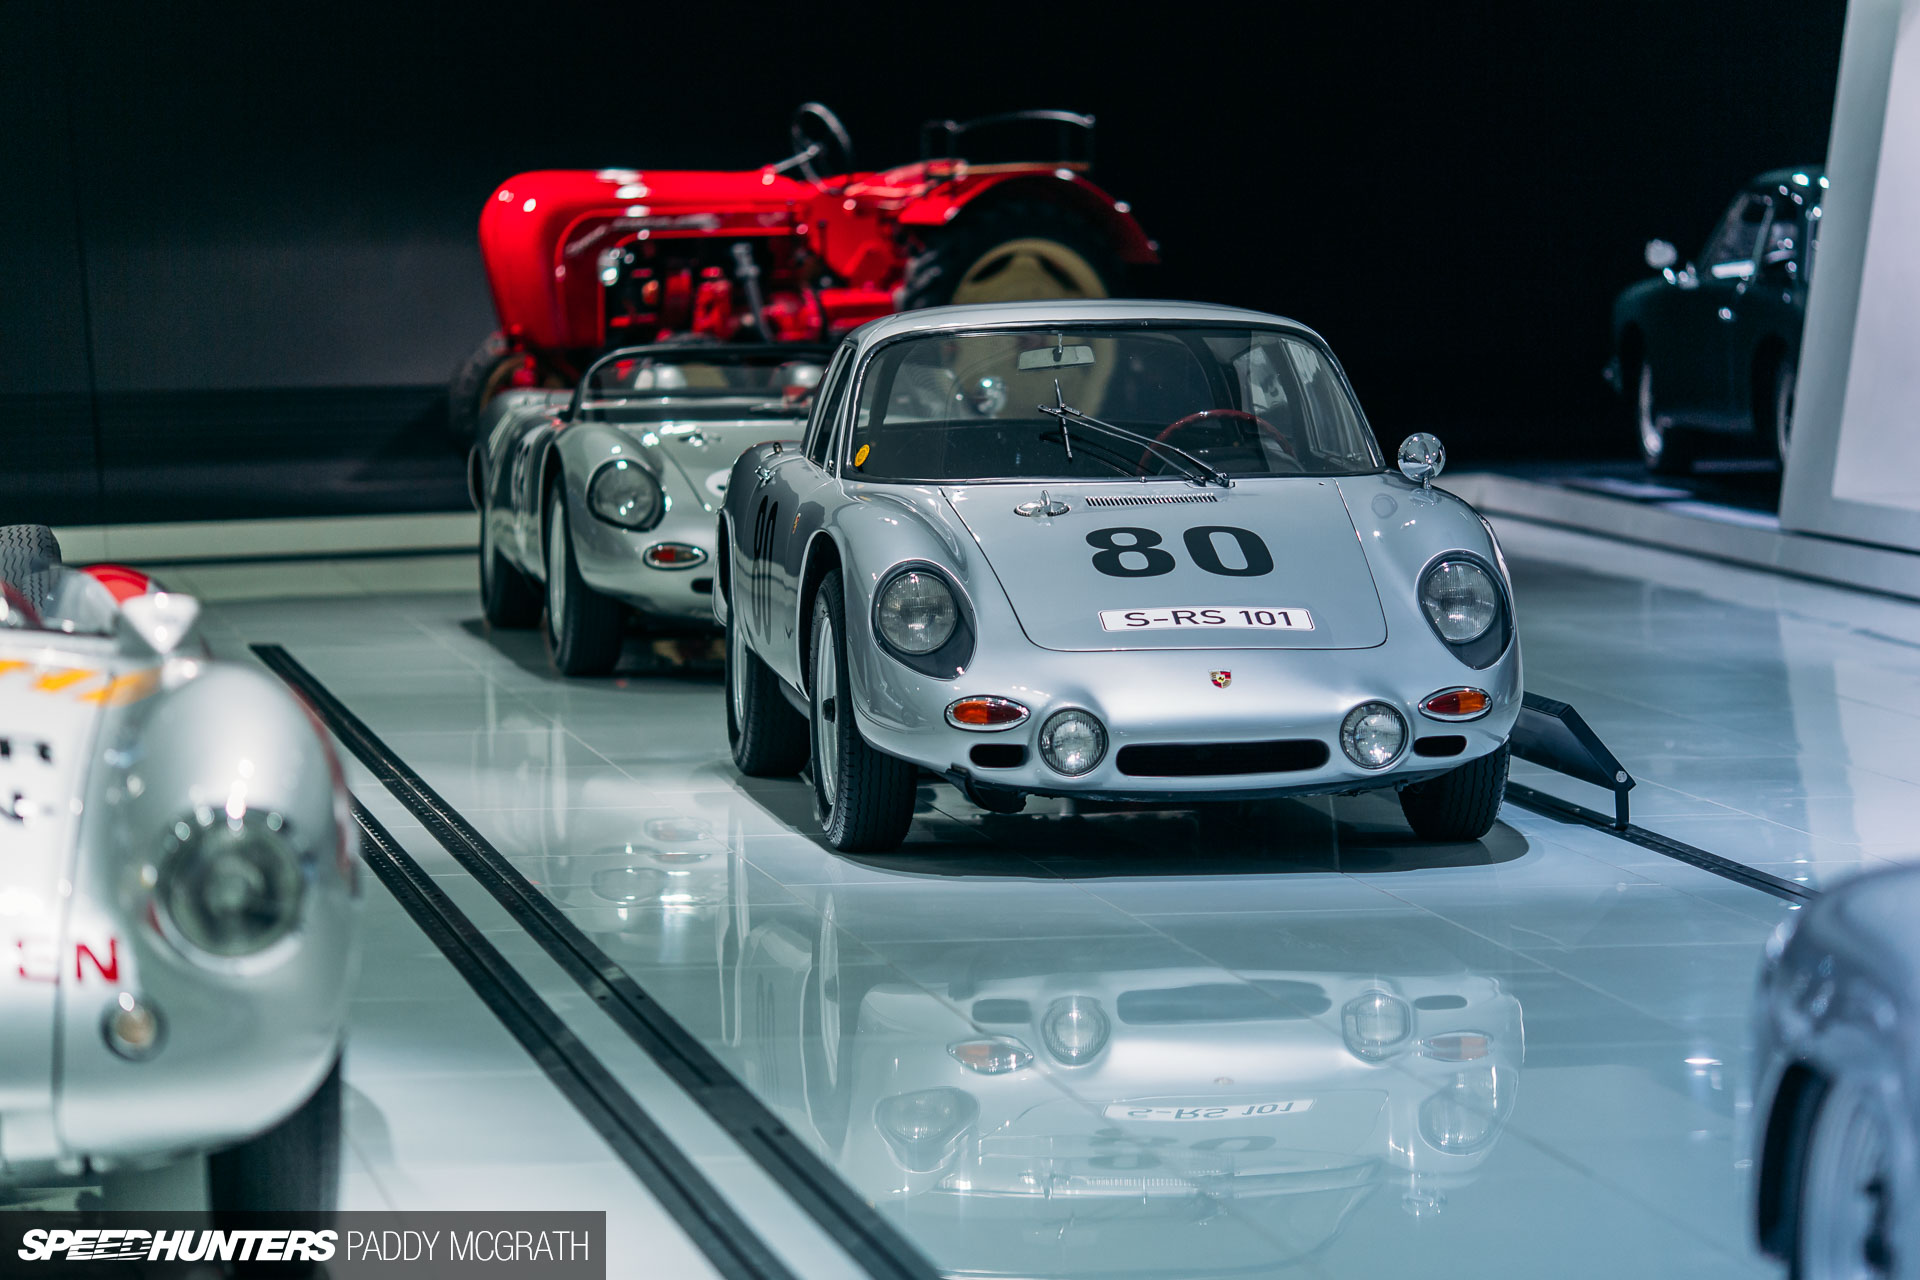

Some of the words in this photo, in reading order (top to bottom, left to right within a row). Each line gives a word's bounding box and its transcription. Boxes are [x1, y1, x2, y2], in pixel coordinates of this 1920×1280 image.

[1085, 525, 1274, 577] 80
[1124, 610, 1226, 627] S-RS
[1238, 610, 1293, 627] 101
